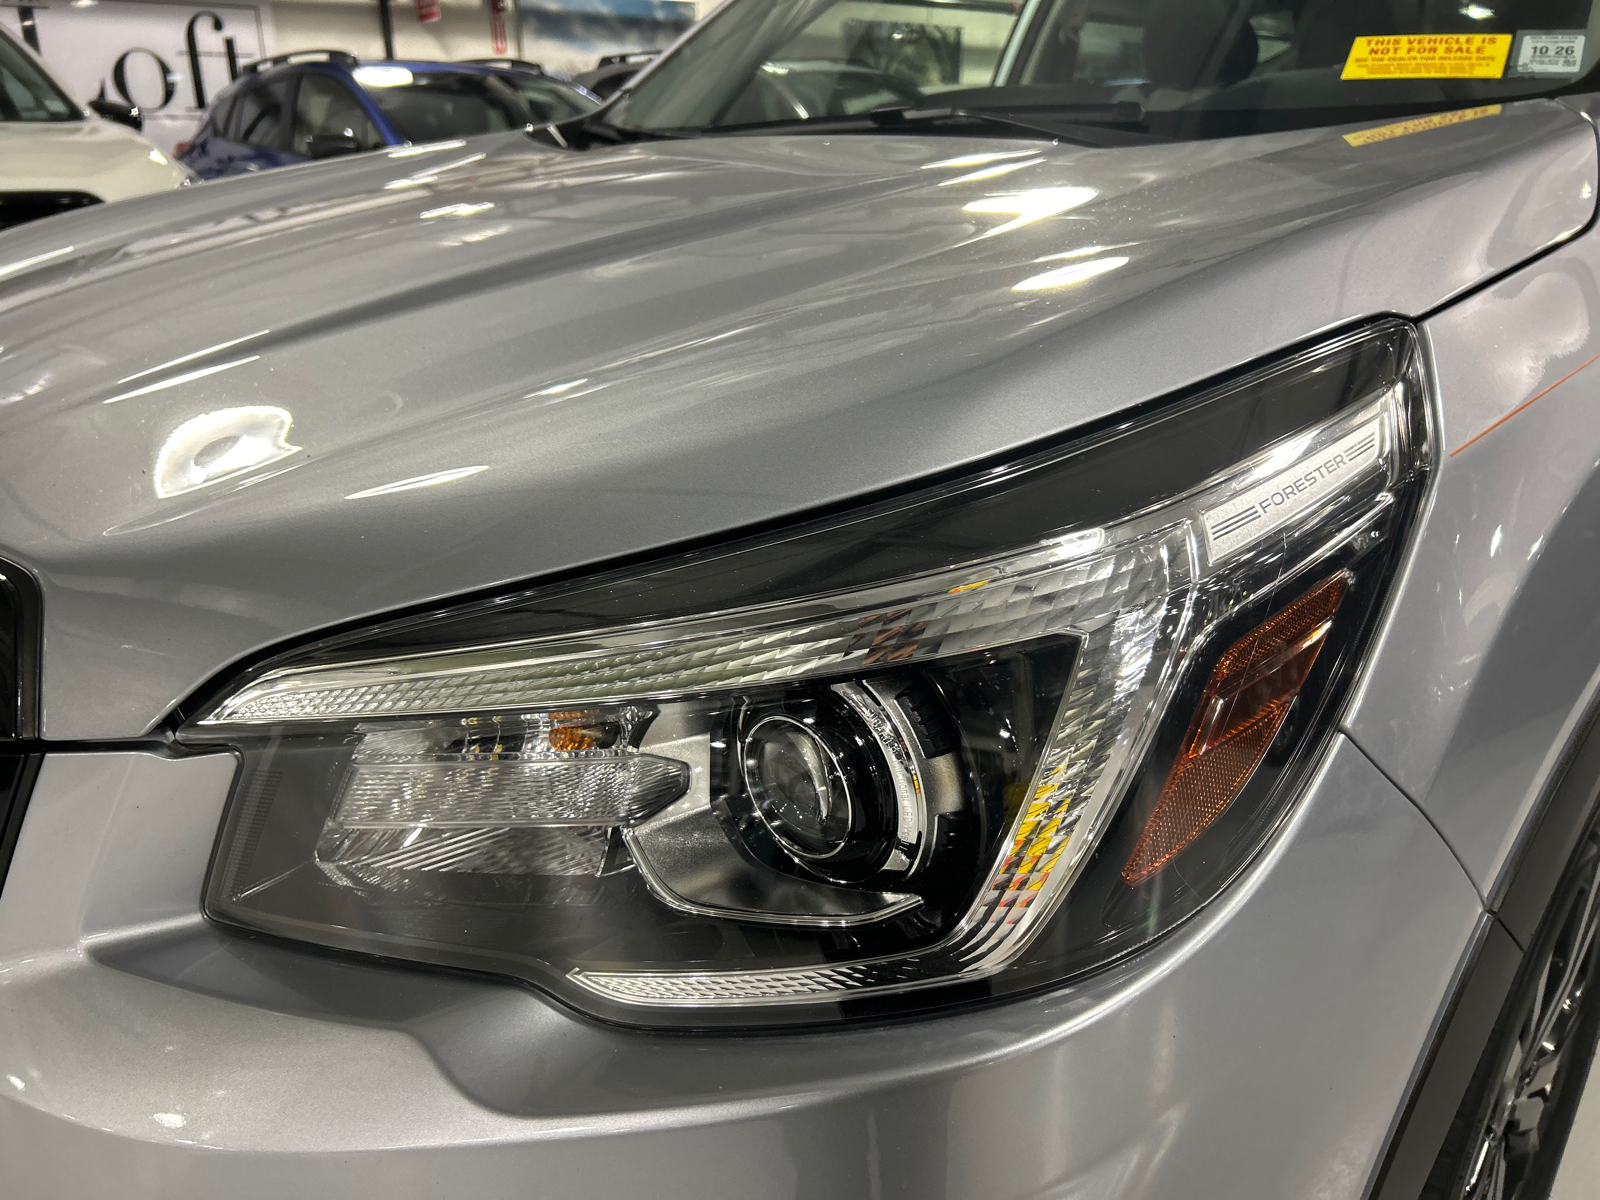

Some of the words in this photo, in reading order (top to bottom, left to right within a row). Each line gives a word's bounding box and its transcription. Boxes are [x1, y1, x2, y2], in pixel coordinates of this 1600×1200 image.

[1366, 37, 1401, 47] THIS
[1407, 36, 1475, 46] VEHICLE
[1481, 36, 1497, 45] IS
[1368, 46, 1402, 56] NOT
[1407, 46, 1438, 54] FOR
[1444, 45, 1486, 54] SALE
[1531, 45, 1549, 55] 10
[1554, 45, 1575, 55] 26
[1258, 453, 1346, 514] FORESTER
